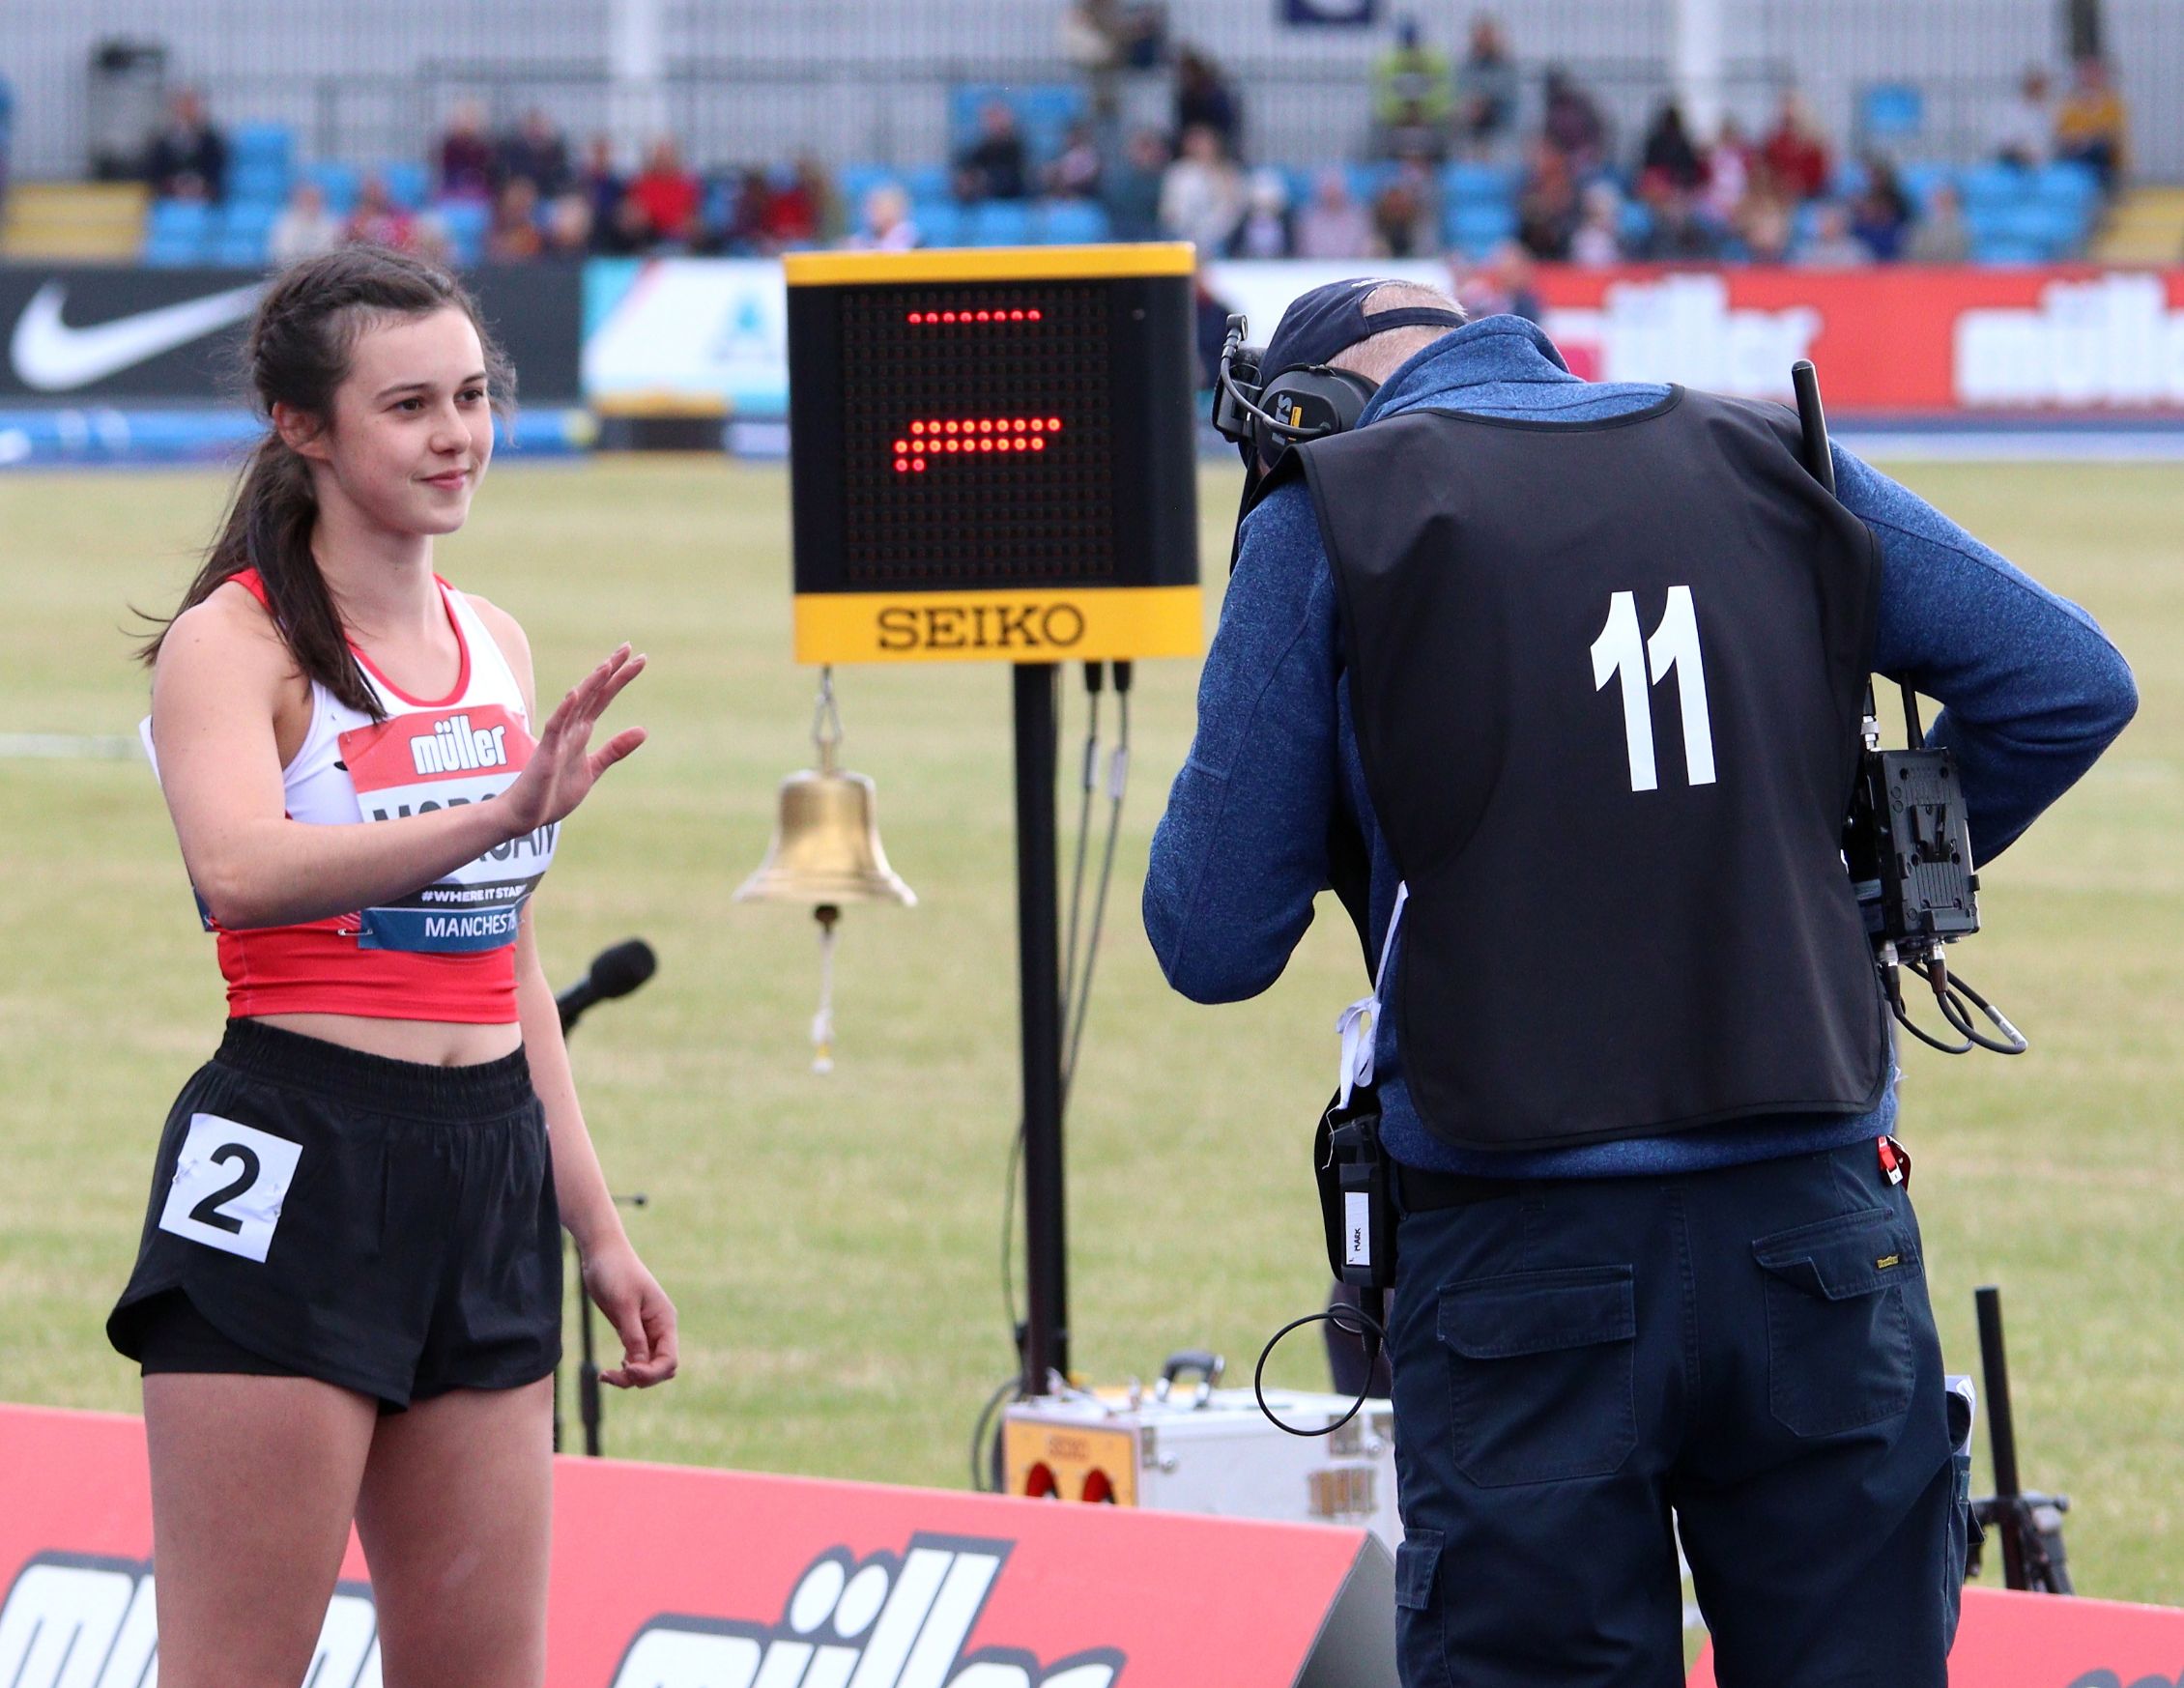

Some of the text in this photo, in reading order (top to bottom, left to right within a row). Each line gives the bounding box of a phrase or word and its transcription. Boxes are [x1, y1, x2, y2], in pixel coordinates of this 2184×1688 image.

[877, 603, 1085, 650] SEIKO
[1590, 586, 1717, 792] 11
[410, 715, 508, 776] müller
[188, 1142, 261, 1236] 2
